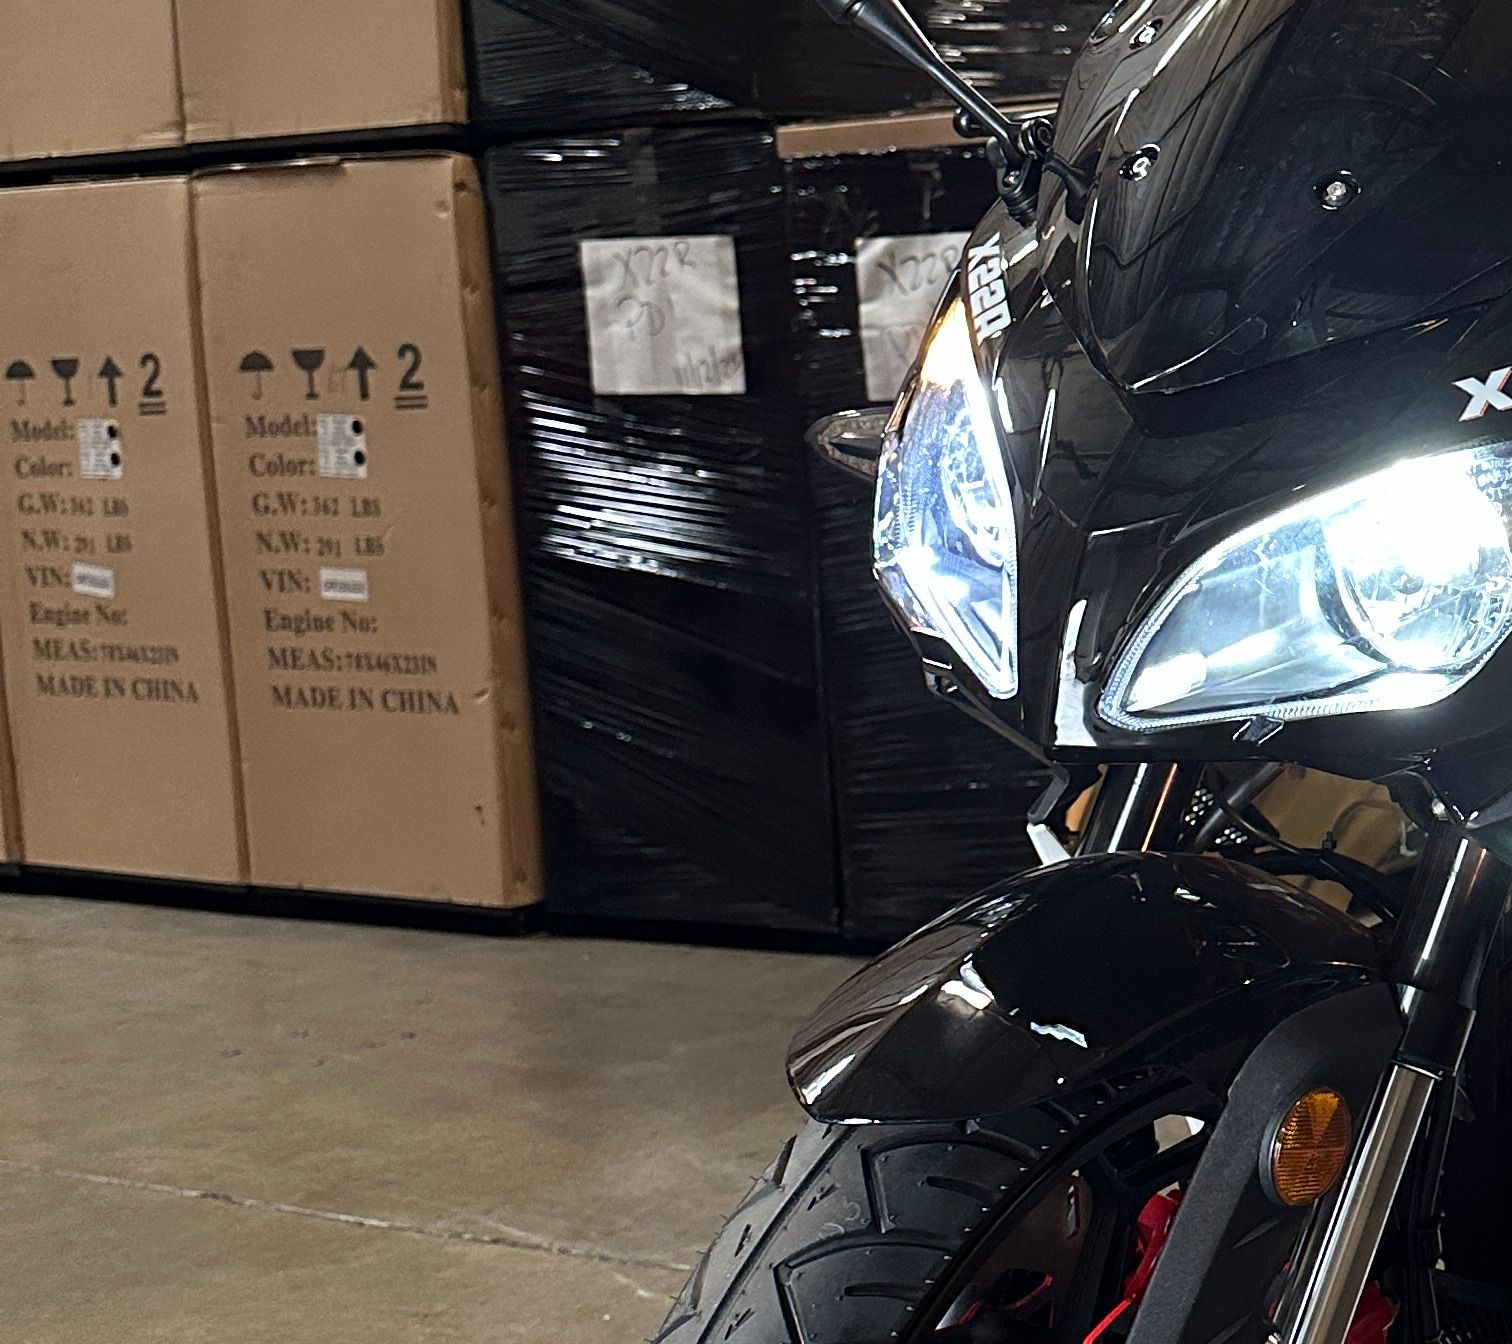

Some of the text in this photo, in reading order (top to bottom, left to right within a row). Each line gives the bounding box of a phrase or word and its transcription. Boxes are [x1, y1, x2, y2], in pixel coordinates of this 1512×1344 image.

[968, 232, 1012, 347] X22R
[140, 352, 164, 398] 2
[397, 343, 425, 391] 2
[244, 413, 318, 439] Model:
[249, 452, 317, 478] Color:
[260, 568, 312, 594] VIN:
[264, 607, 379, 639] Engine No:
[36, 673, 199, 703] MADE IN CHINA
[272, 684, 460, 716] MADE IN CHINA
